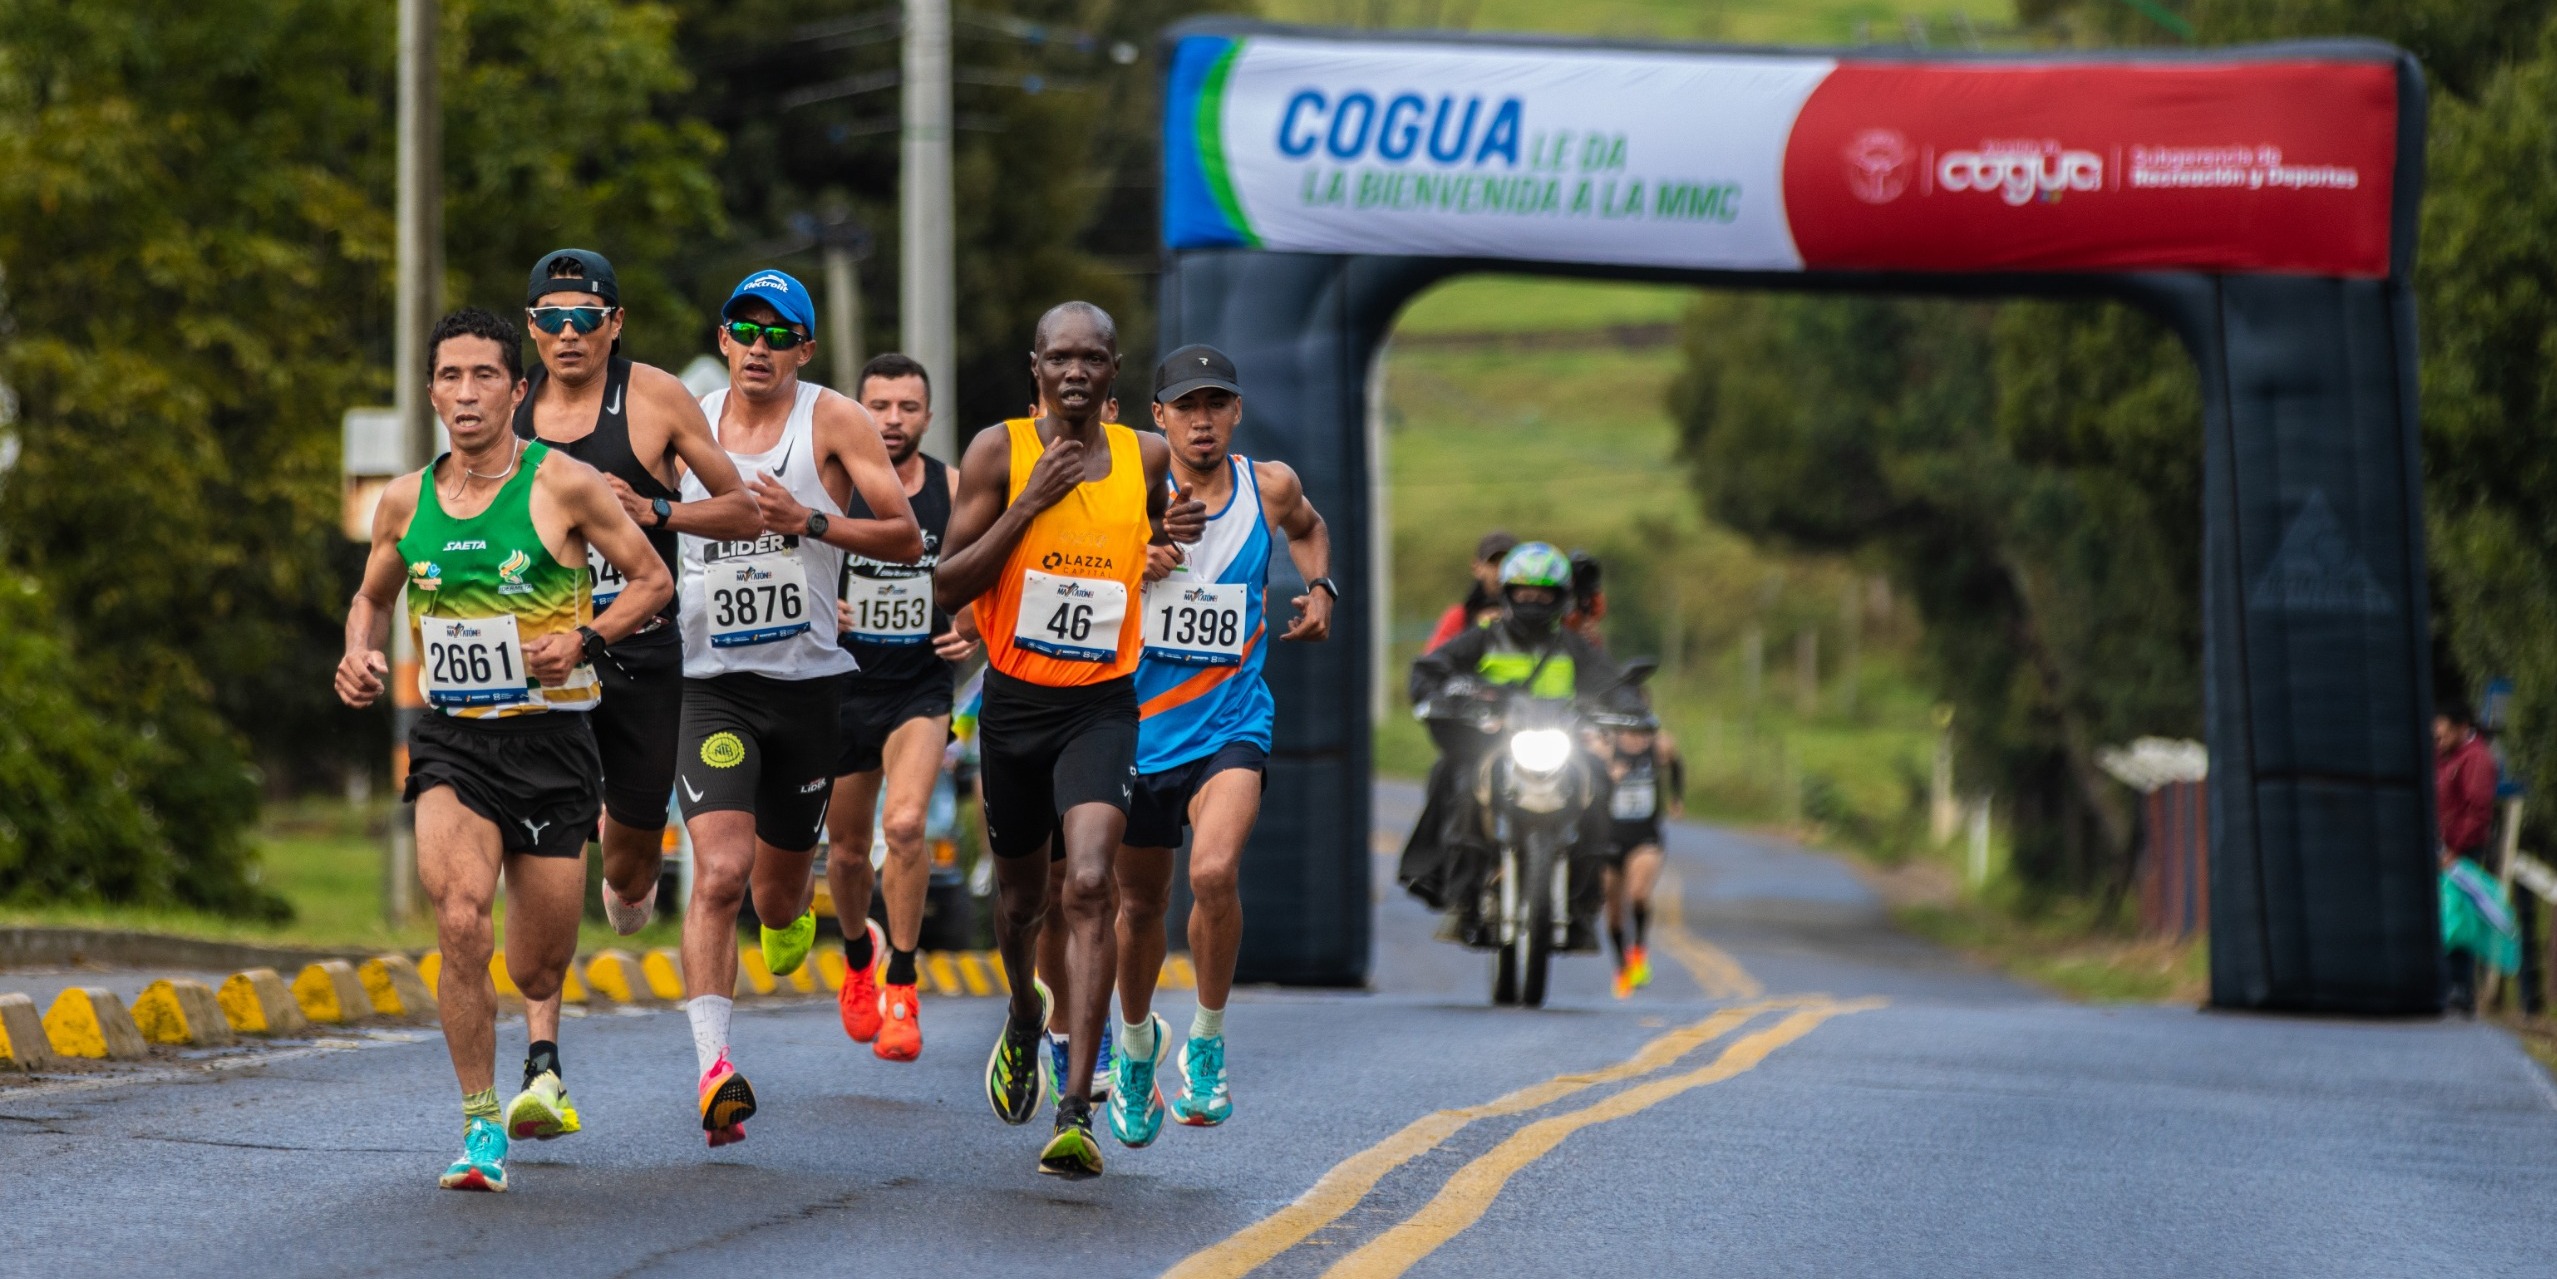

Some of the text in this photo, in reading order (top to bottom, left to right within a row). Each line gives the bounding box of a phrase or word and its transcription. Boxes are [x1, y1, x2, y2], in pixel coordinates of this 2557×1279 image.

[1275, 86, 1628, 175] COGUA LE DA
[1302, 164, 1743, 226] LA BIENVENIDA A LA MMC
[442, 540, 487, 552] SAETA
[1065, 554, 1113, 570] LAZZA
[1063, 567, 1112, 579] CAPITAL
[713, 583, 802, 627] 3876
[858, 598, 925, 630] 1553
[1046, 602, 1094, 642] 46
[1161, 606, 1239, 646] 1398
[430, 641, 513, 684] 2661
